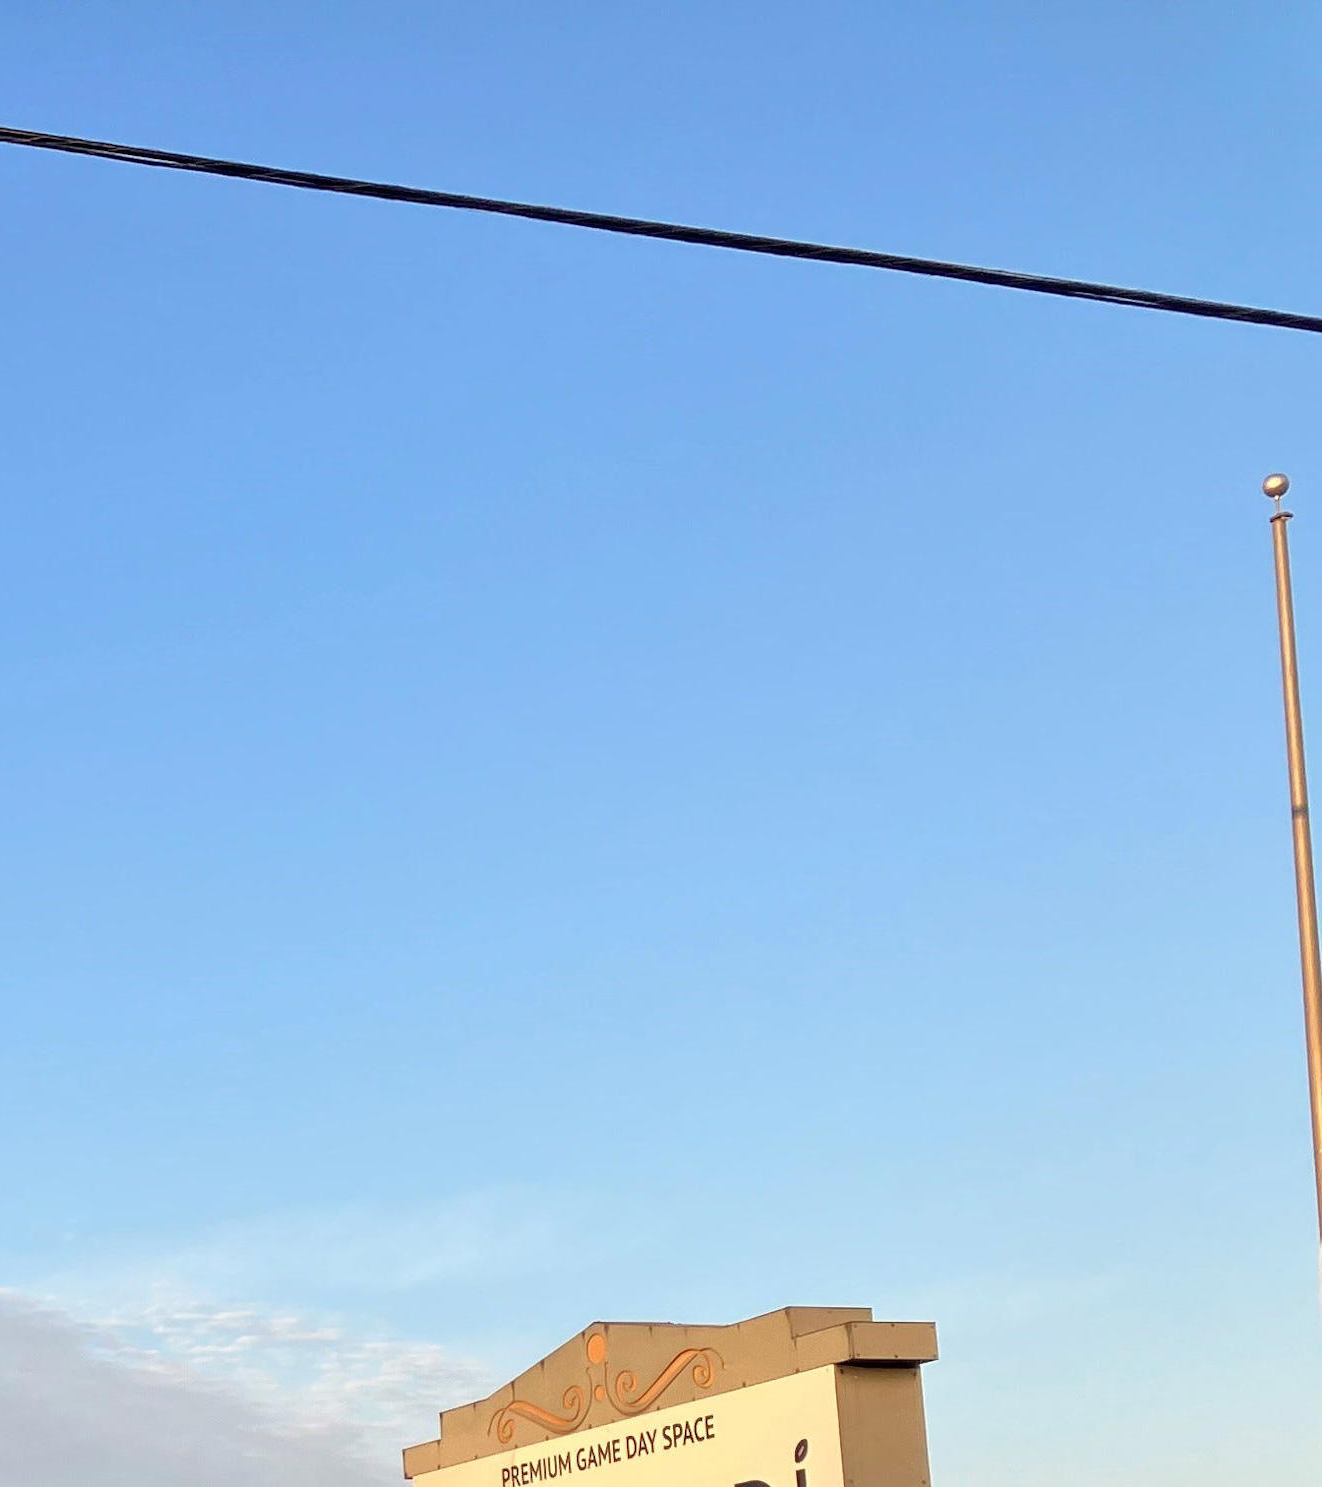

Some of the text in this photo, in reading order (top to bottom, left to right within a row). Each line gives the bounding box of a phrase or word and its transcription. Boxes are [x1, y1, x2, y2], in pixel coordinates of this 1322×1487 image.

[576, 1438, 622, 1472] GAME
[626, 1429, 658, 1460] DAY
[662, 1415, 716, 1449] SPACE
